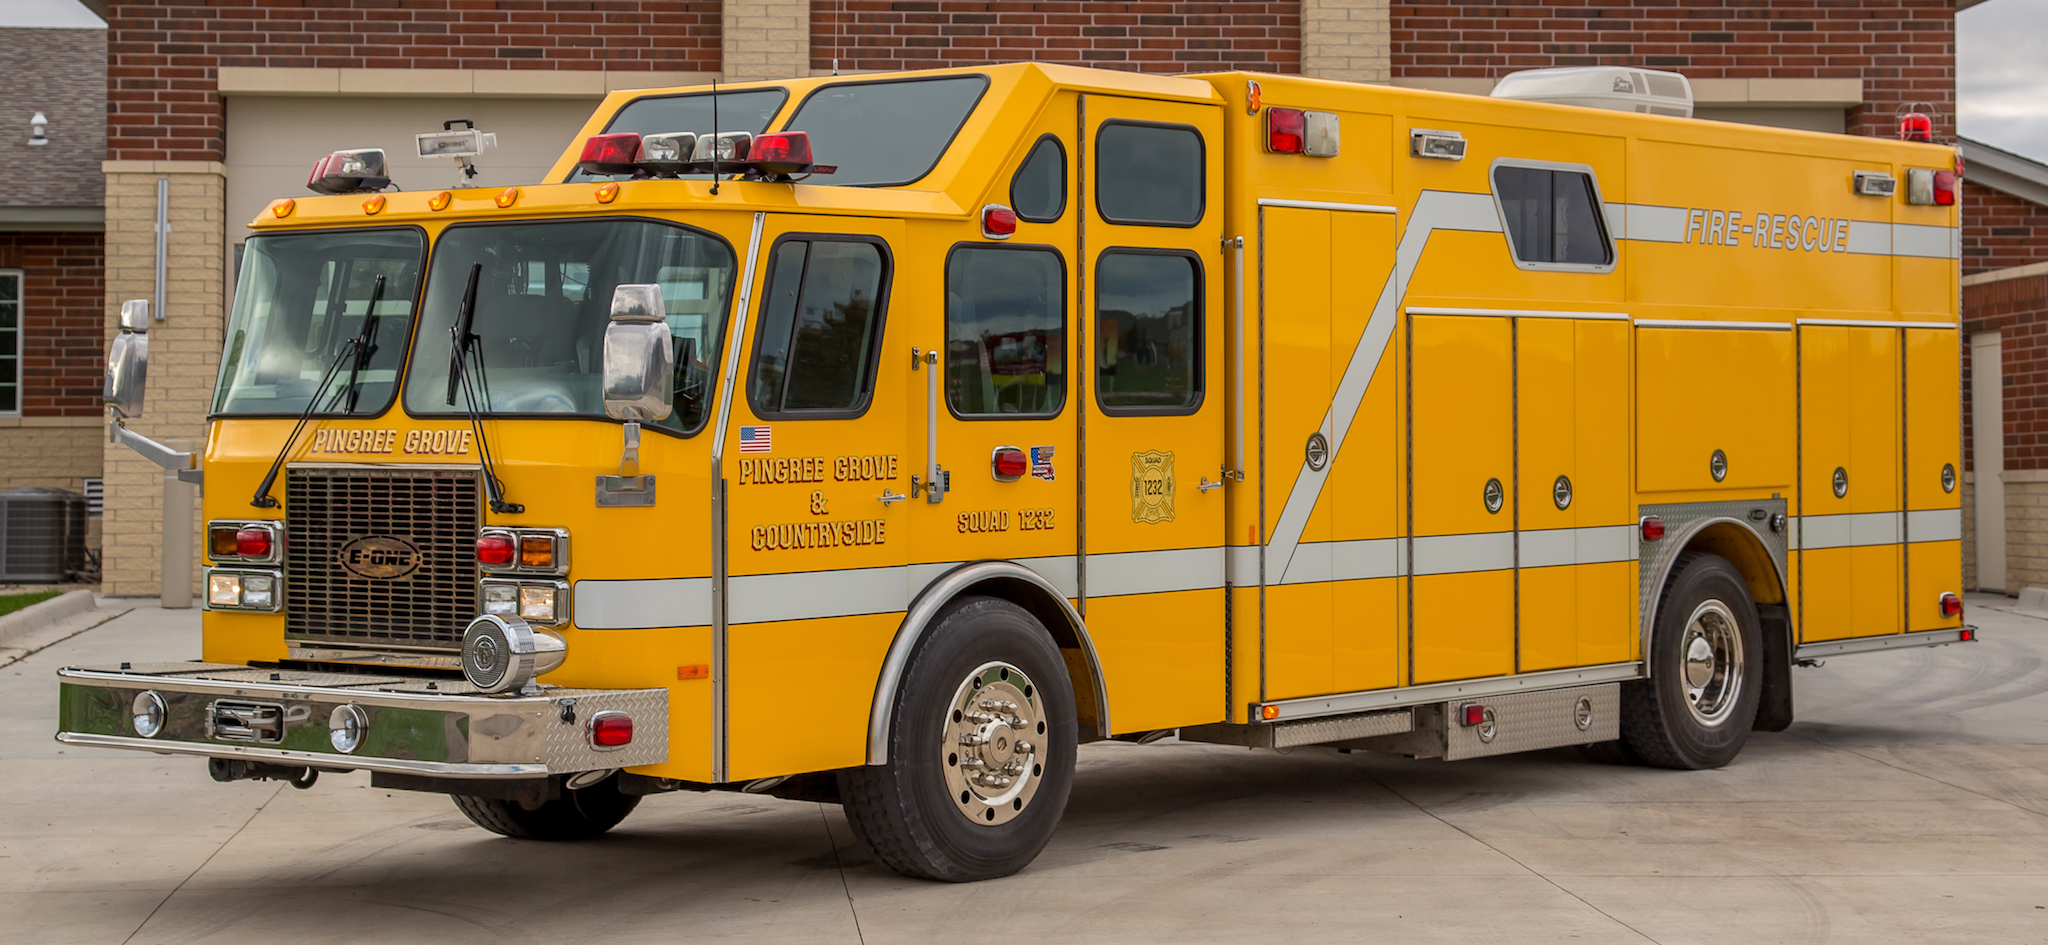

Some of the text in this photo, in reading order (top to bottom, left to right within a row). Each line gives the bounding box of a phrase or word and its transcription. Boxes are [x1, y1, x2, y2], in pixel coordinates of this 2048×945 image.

[1686, 208, 1848, 253] FIRE-RESCUE
[312, 429, 473, 455] PINGREE GROVE
[739, 455, 898, 485] PINGREE GROVE
[1144, 479, 1163, 495] 1232
[810, 490, 829, 515] &
[958, 508, 1055, 533] SQUAD 1232
[751, 519, 886, 551] COUNTRYSIDE
[350, 549, 411, 566] E-ONE
